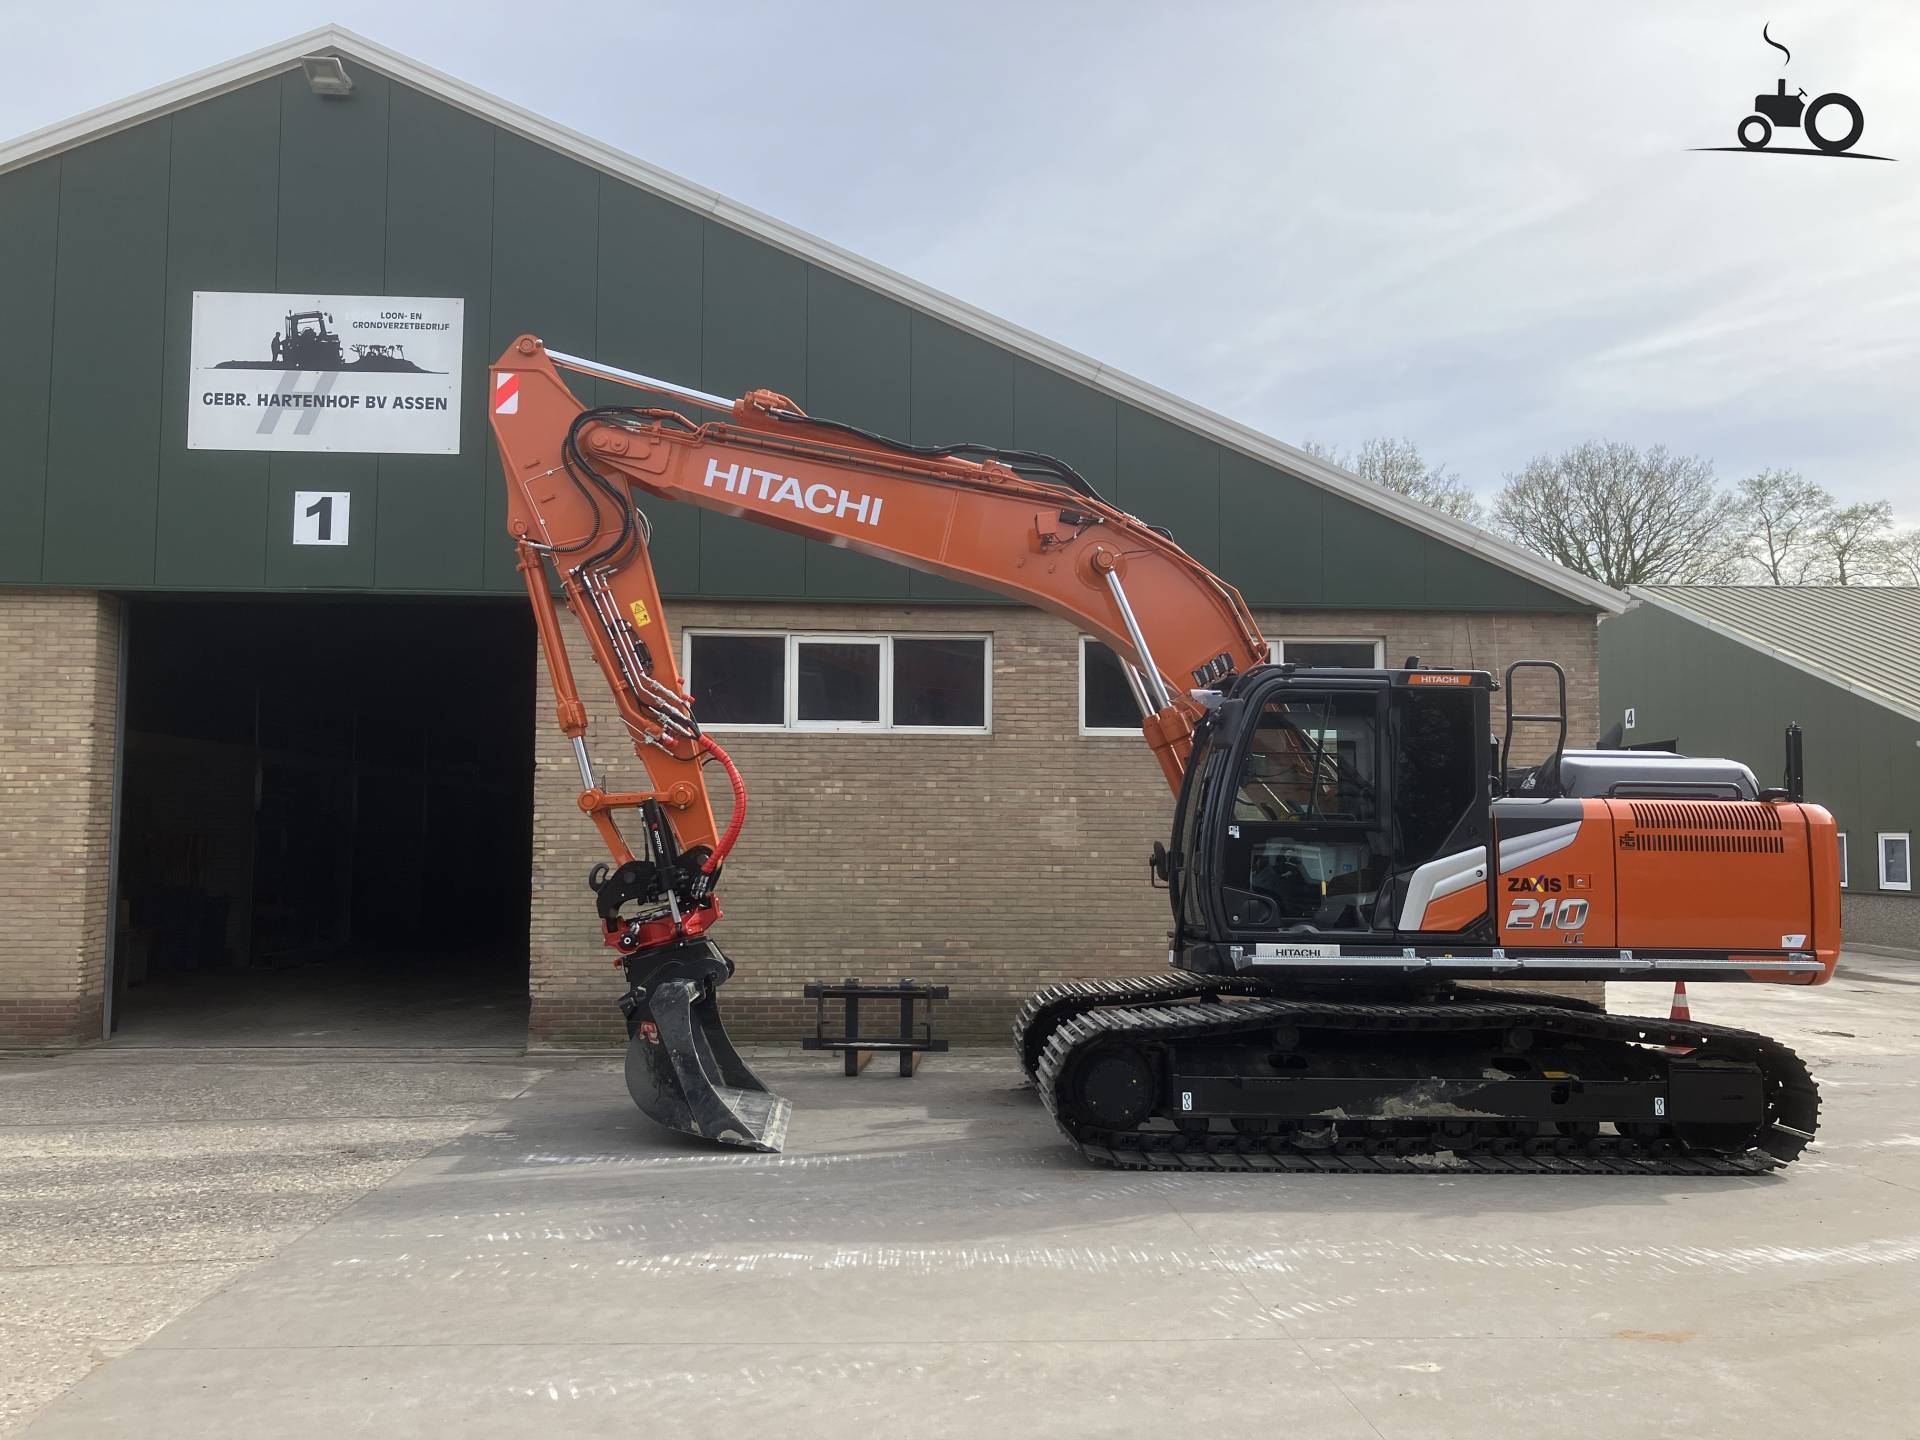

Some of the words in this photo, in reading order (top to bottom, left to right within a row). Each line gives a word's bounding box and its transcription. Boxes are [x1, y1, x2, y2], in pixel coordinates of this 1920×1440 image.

[380, 312, 408, 320] LOON-
[410, 312, 422, 320] EN
[352, 321, 450, 331] GRONDVERZETBEDRIJF
[202, 392, 251, 407] GEBR.
[257, 393, 360, 409] HARTENHOF
[365, 396, 387, 409] BV
[392, 396, 448, 411] ASSEN
[703, 458, 883, 526] HITACHI
[306, 496, 333, 541] 1
[1421, 676, 1459, 684] HITACHI
[1626, 710, 1634, 727] 4
[1507, 874, 1562, 893] ZAXIS
[1505, 898, 1590, 930] 210
[1275, 948, 1321, 957] HITACHI
